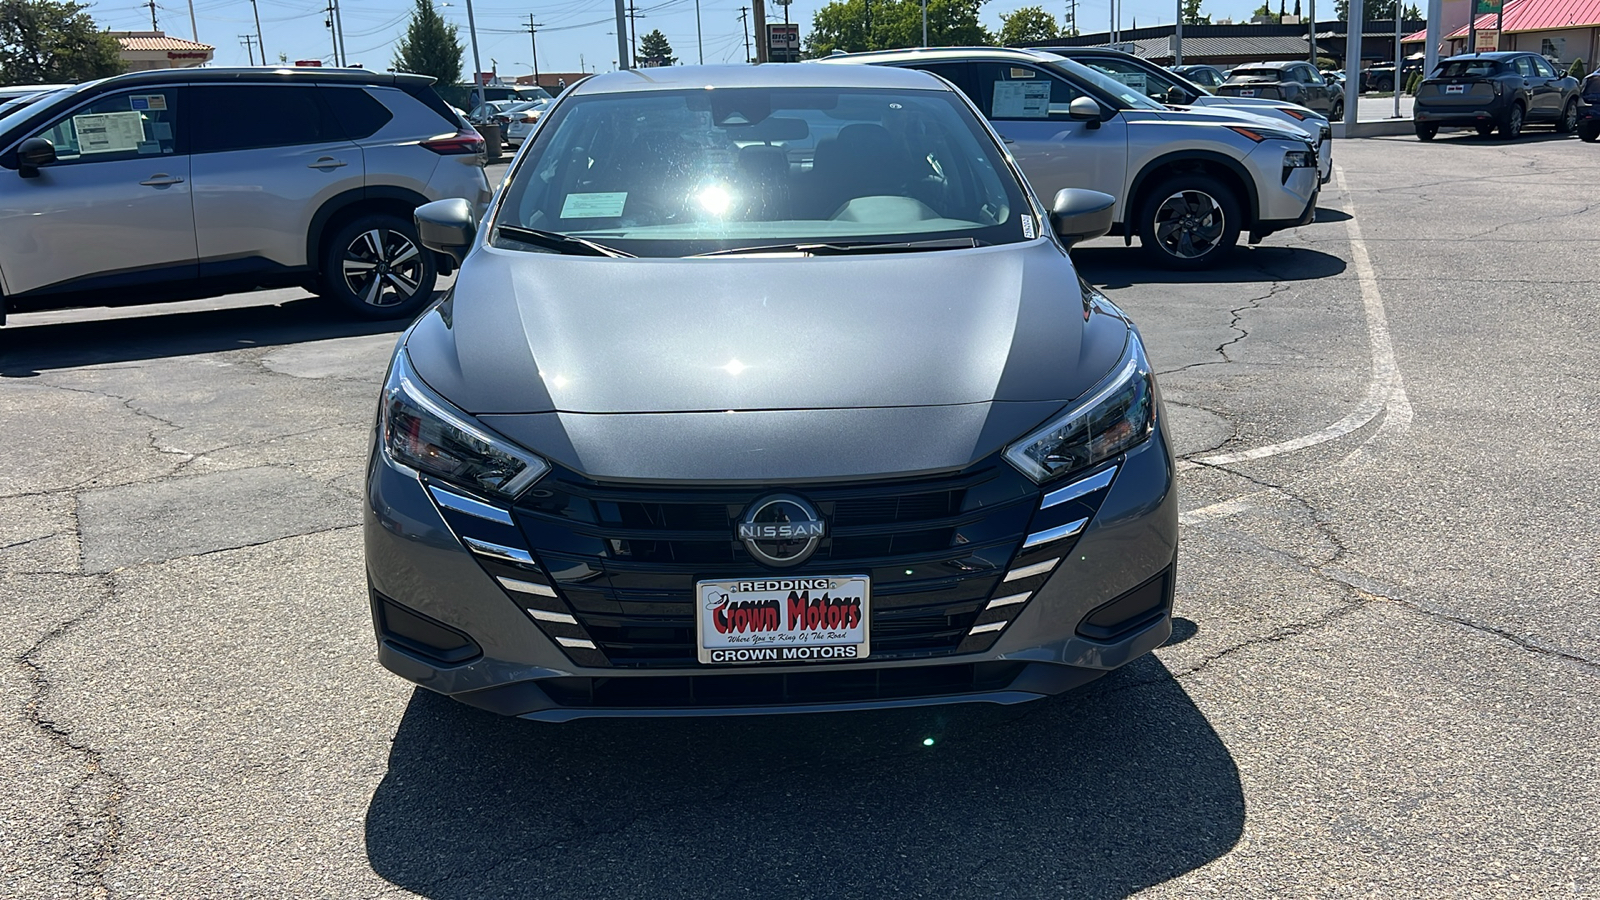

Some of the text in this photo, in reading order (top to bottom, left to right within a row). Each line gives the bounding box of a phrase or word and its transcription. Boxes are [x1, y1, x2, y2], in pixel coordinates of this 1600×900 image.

[740, 523, 823, 537] NISSAN
[739, 579, 828, 592] REDDING
[713, 591, 861, 634] Crown Motors
[727, 631, 847, 645] Where You're King Of The Road
[712, 646, 857, 662] CROWN MOTORS
